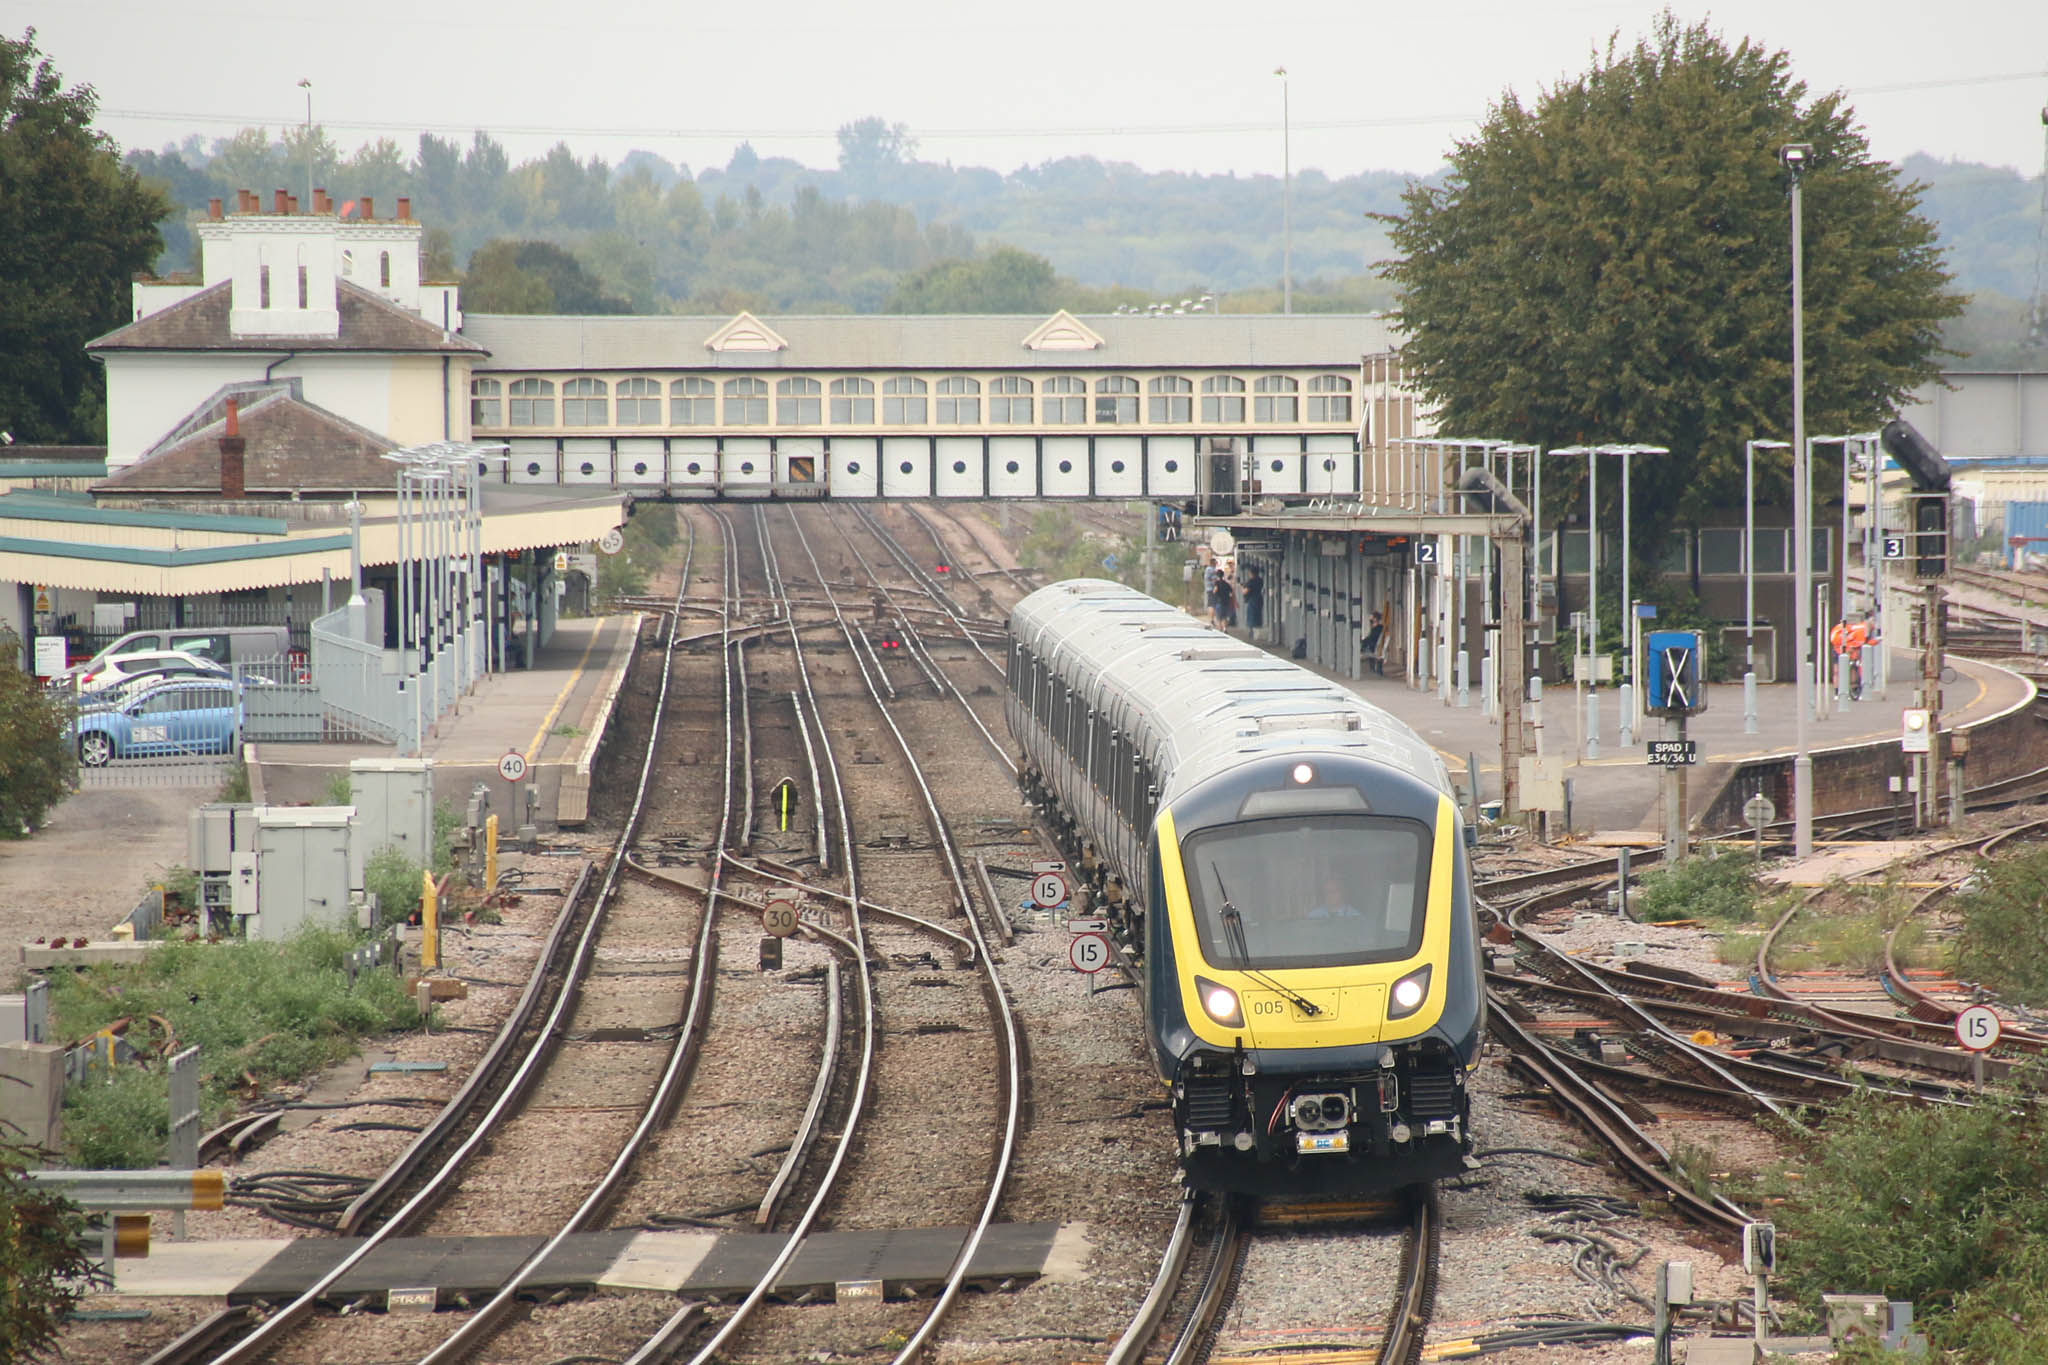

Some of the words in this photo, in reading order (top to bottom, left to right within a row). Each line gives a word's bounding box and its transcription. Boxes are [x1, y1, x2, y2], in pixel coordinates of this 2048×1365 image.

[602, 533, 619, 549] 65
[1887, 540, 1900, 557] 3
[1421, 545, 1433, 561] 2
[1655, 743, 1682, 753] SPAD
[1647, 753, 1685, 763] E34/36
[1688, 753, 1696, 763] U
[503, 760, 522, 773] 40
[1041, 883, 1057, 899] 15
[769, 910, 791, 928] 30
[1080, 944, 1098, 962] 15
[1254, 1001, 1283, 1015] 005
[1969, 1018, 1987, 1038] 15
